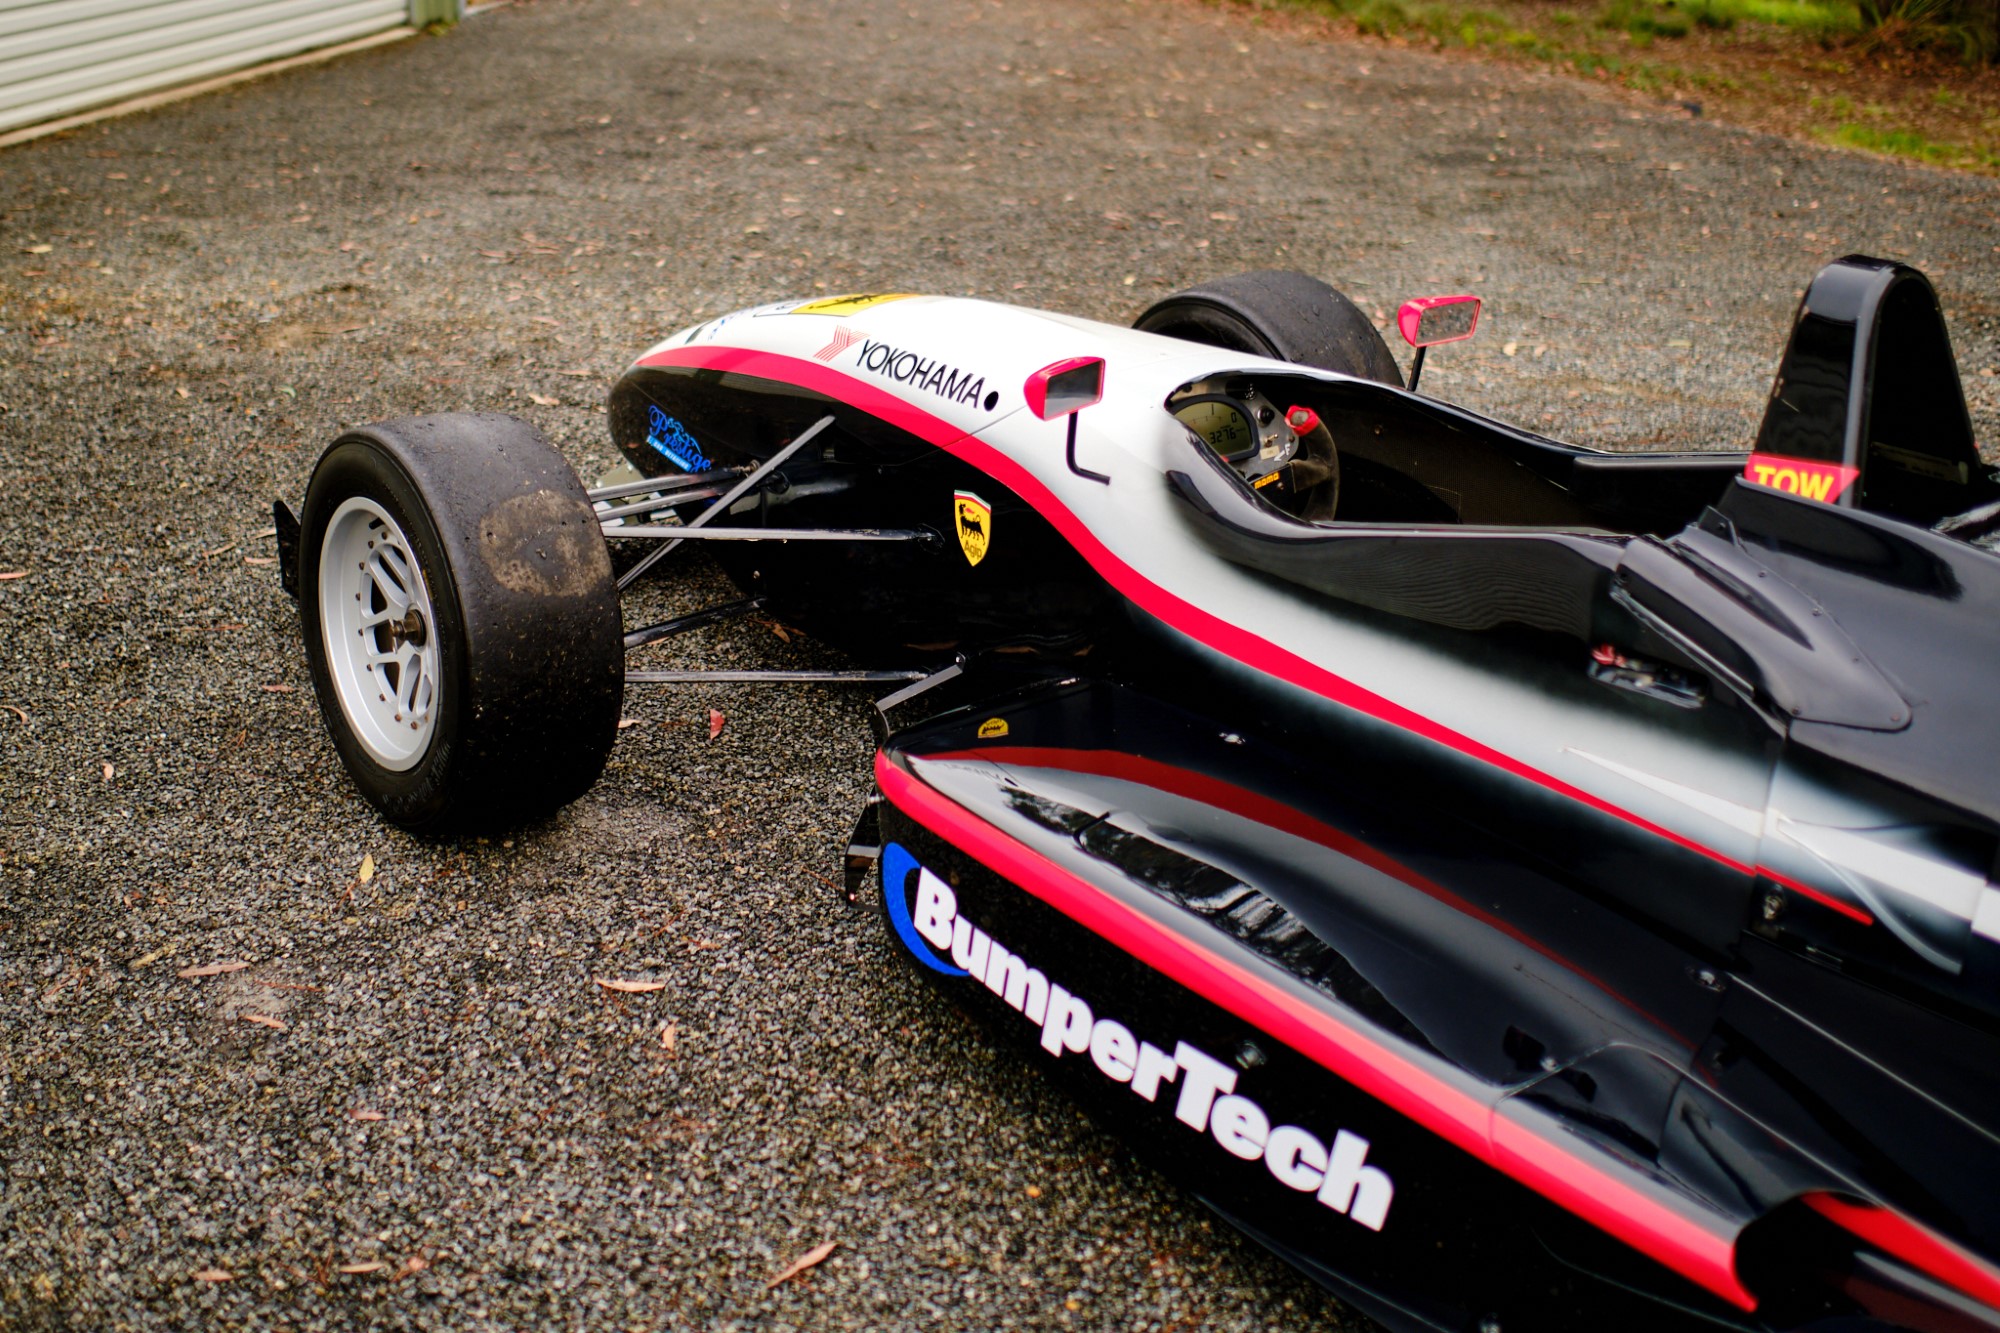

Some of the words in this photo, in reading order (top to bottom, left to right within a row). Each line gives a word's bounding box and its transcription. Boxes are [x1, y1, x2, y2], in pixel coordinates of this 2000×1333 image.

[856, 339, 985, 408] YOKOHAMA
[648, 405, 711, 473] Prestige
[1209, 427, 1237, 445] 3276
[1753, 464, 1835, 503] TOW
[964, 540, 982, 560] Agip
[913, 865, 1395, 1232] BumperTech
